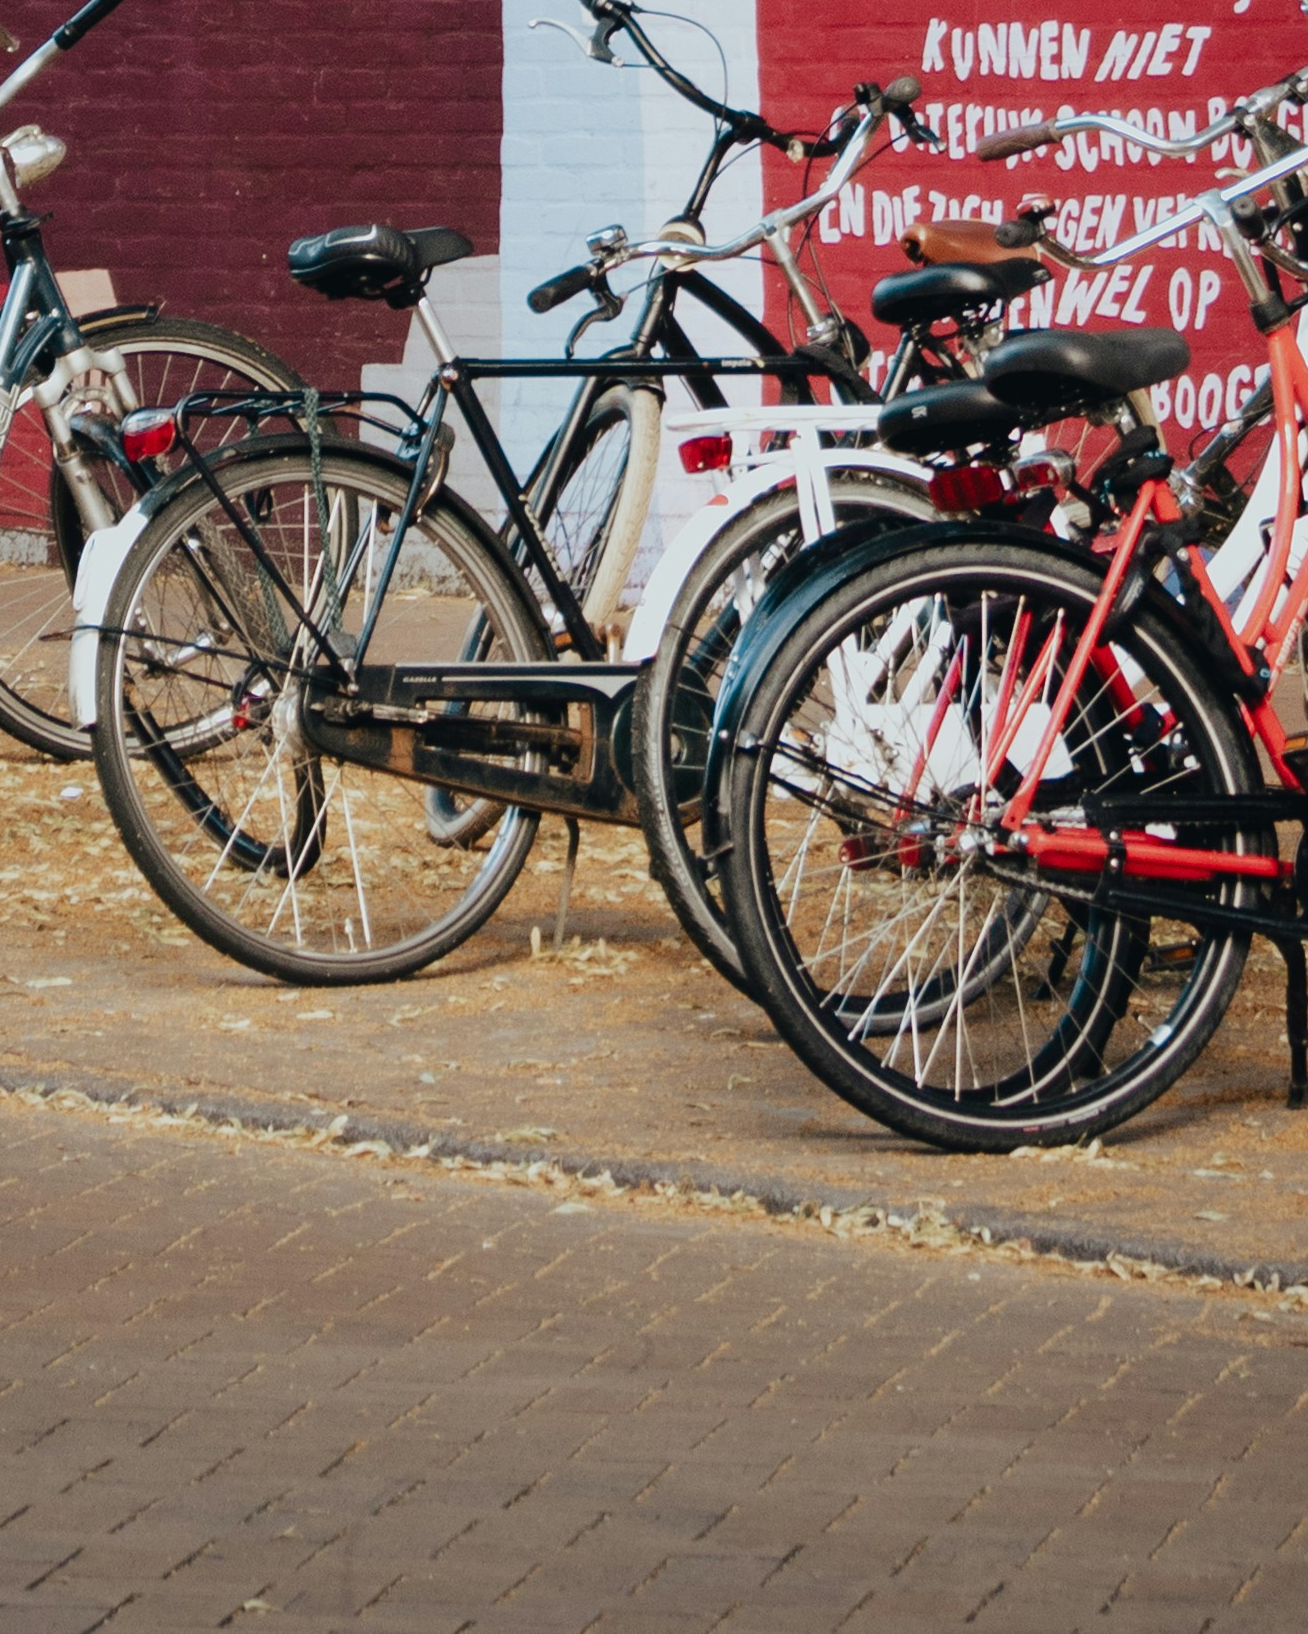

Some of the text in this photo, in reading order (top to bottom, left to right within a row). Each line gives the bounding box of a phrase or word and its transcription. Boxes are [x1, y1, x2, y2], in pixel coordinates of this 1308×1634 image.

[921, 18, 1212, 82] KUNNEN NIET
[1054, 105, 1196, 172] SCHOON
[818, 181, 865, 244] EN
[1054, 264, 1154, 326] WEL
[1168, 267, 1221, 331] OP
[1150, 362, 1272, 433] BOOG
